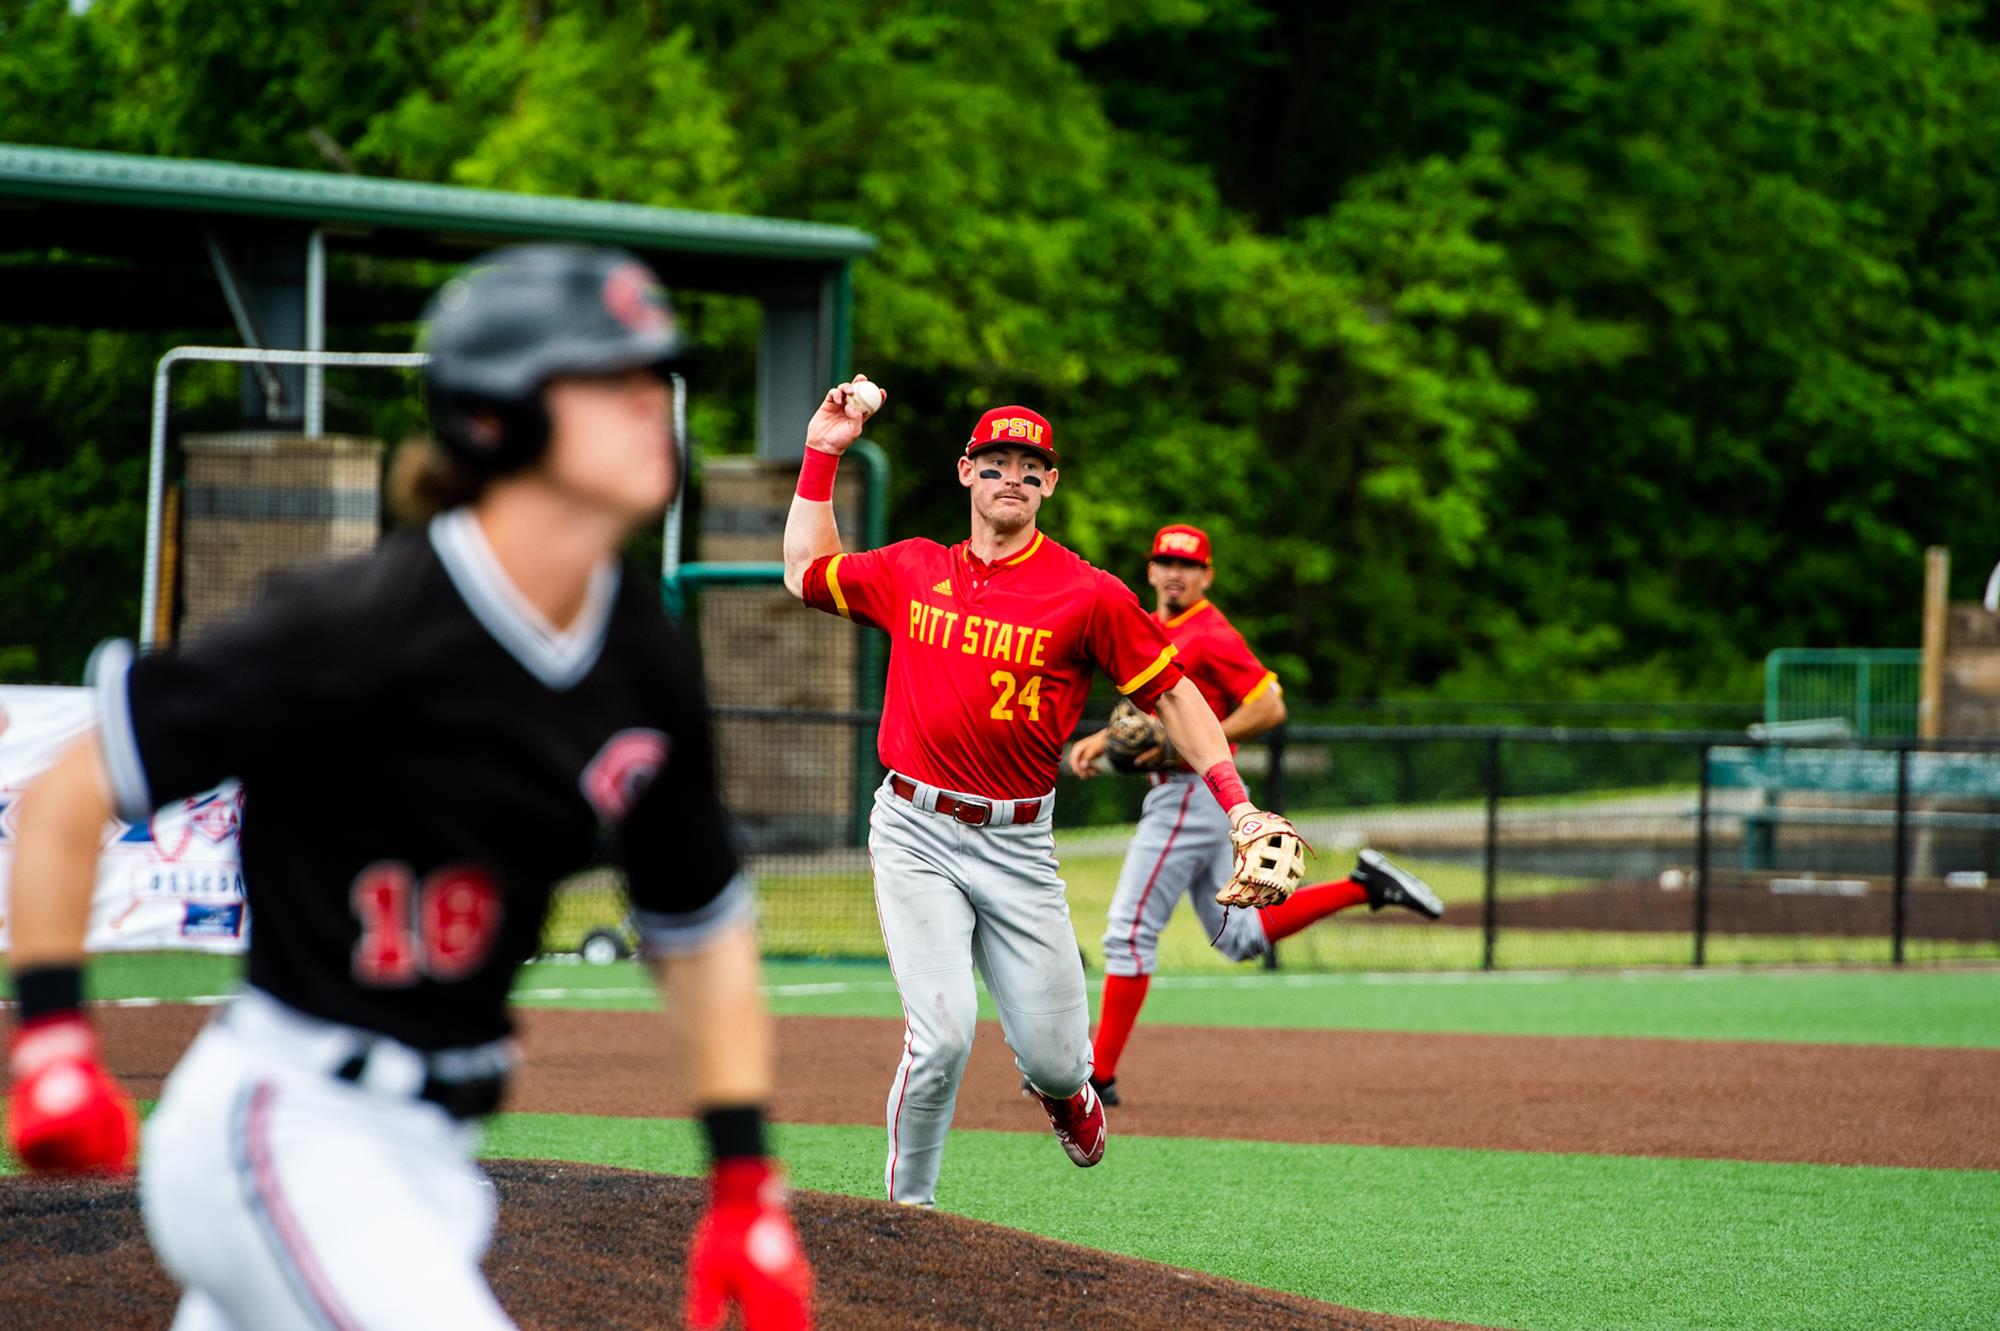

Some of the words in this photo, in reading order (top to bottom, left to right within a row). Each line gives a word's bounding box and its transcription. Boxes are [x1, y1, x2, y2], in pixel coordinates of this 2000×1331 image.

[991, 418, 1043, 444] PSU
[910, 600, 959, 649] PITT
[961, 615, 1053, 667] STATE
[990, 669, 1042, 721] 24
